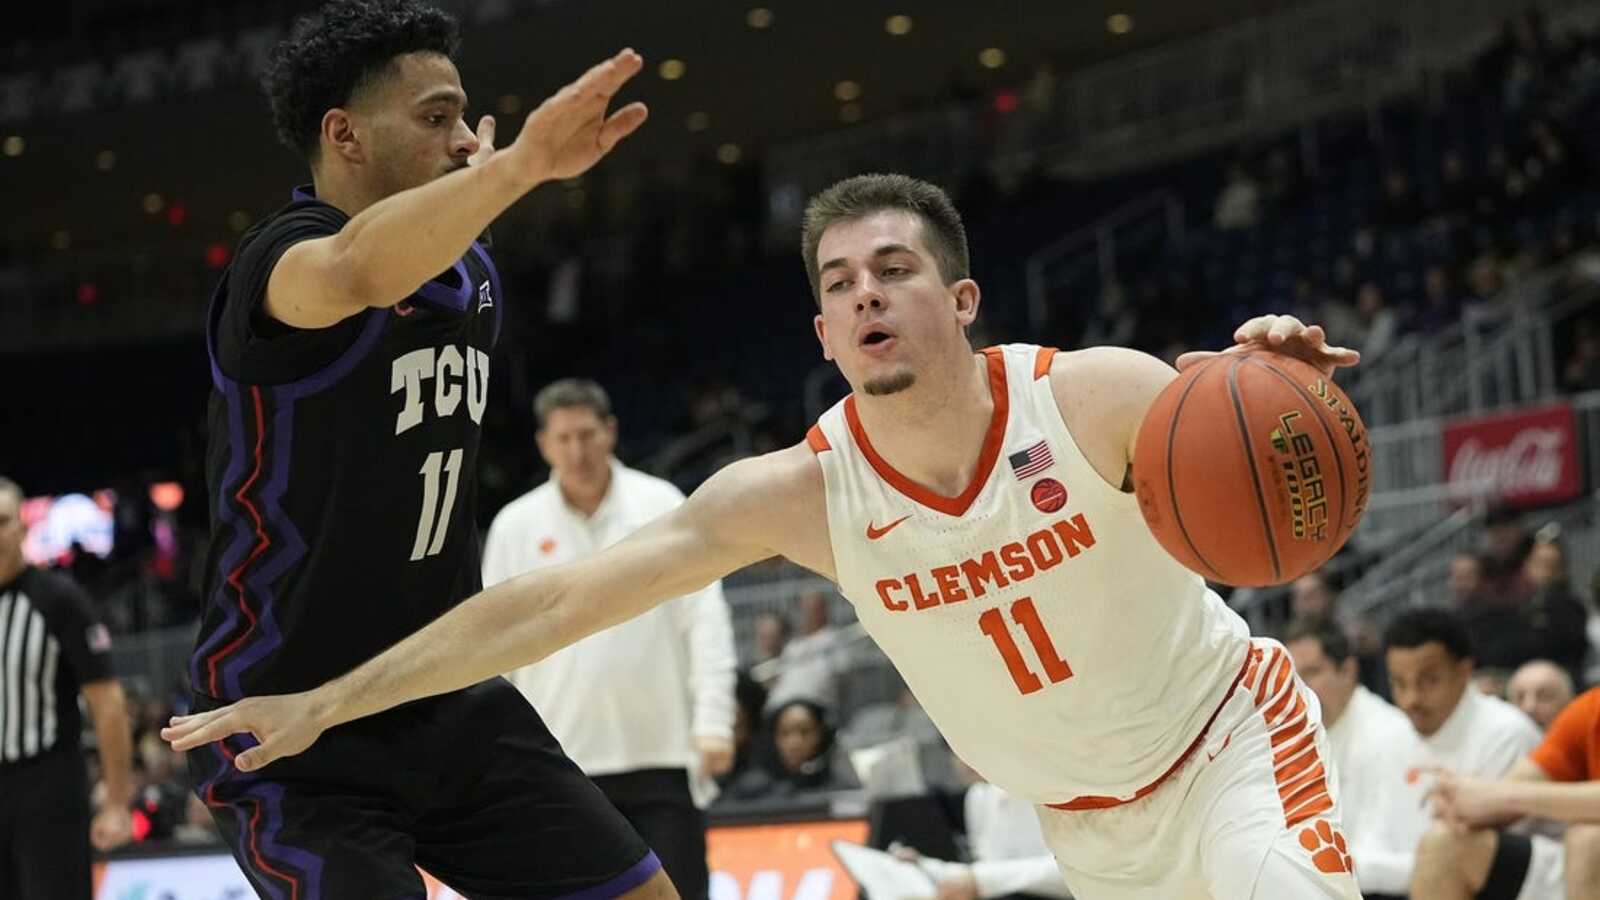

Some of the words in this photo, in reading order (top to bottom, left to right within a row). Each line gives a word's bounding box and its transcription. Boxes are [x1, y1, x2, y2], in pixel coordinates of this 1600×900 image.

[390, 344, 490, 436] TCU
[409, 448, 464, 561] 11
[1280, 410, 1328, 542] LEGACY
[1282, 459, 1305, 540] 1000
[875, 512, 1096, 612] CLEMSON
[978, 596, 1074, 695] 11
